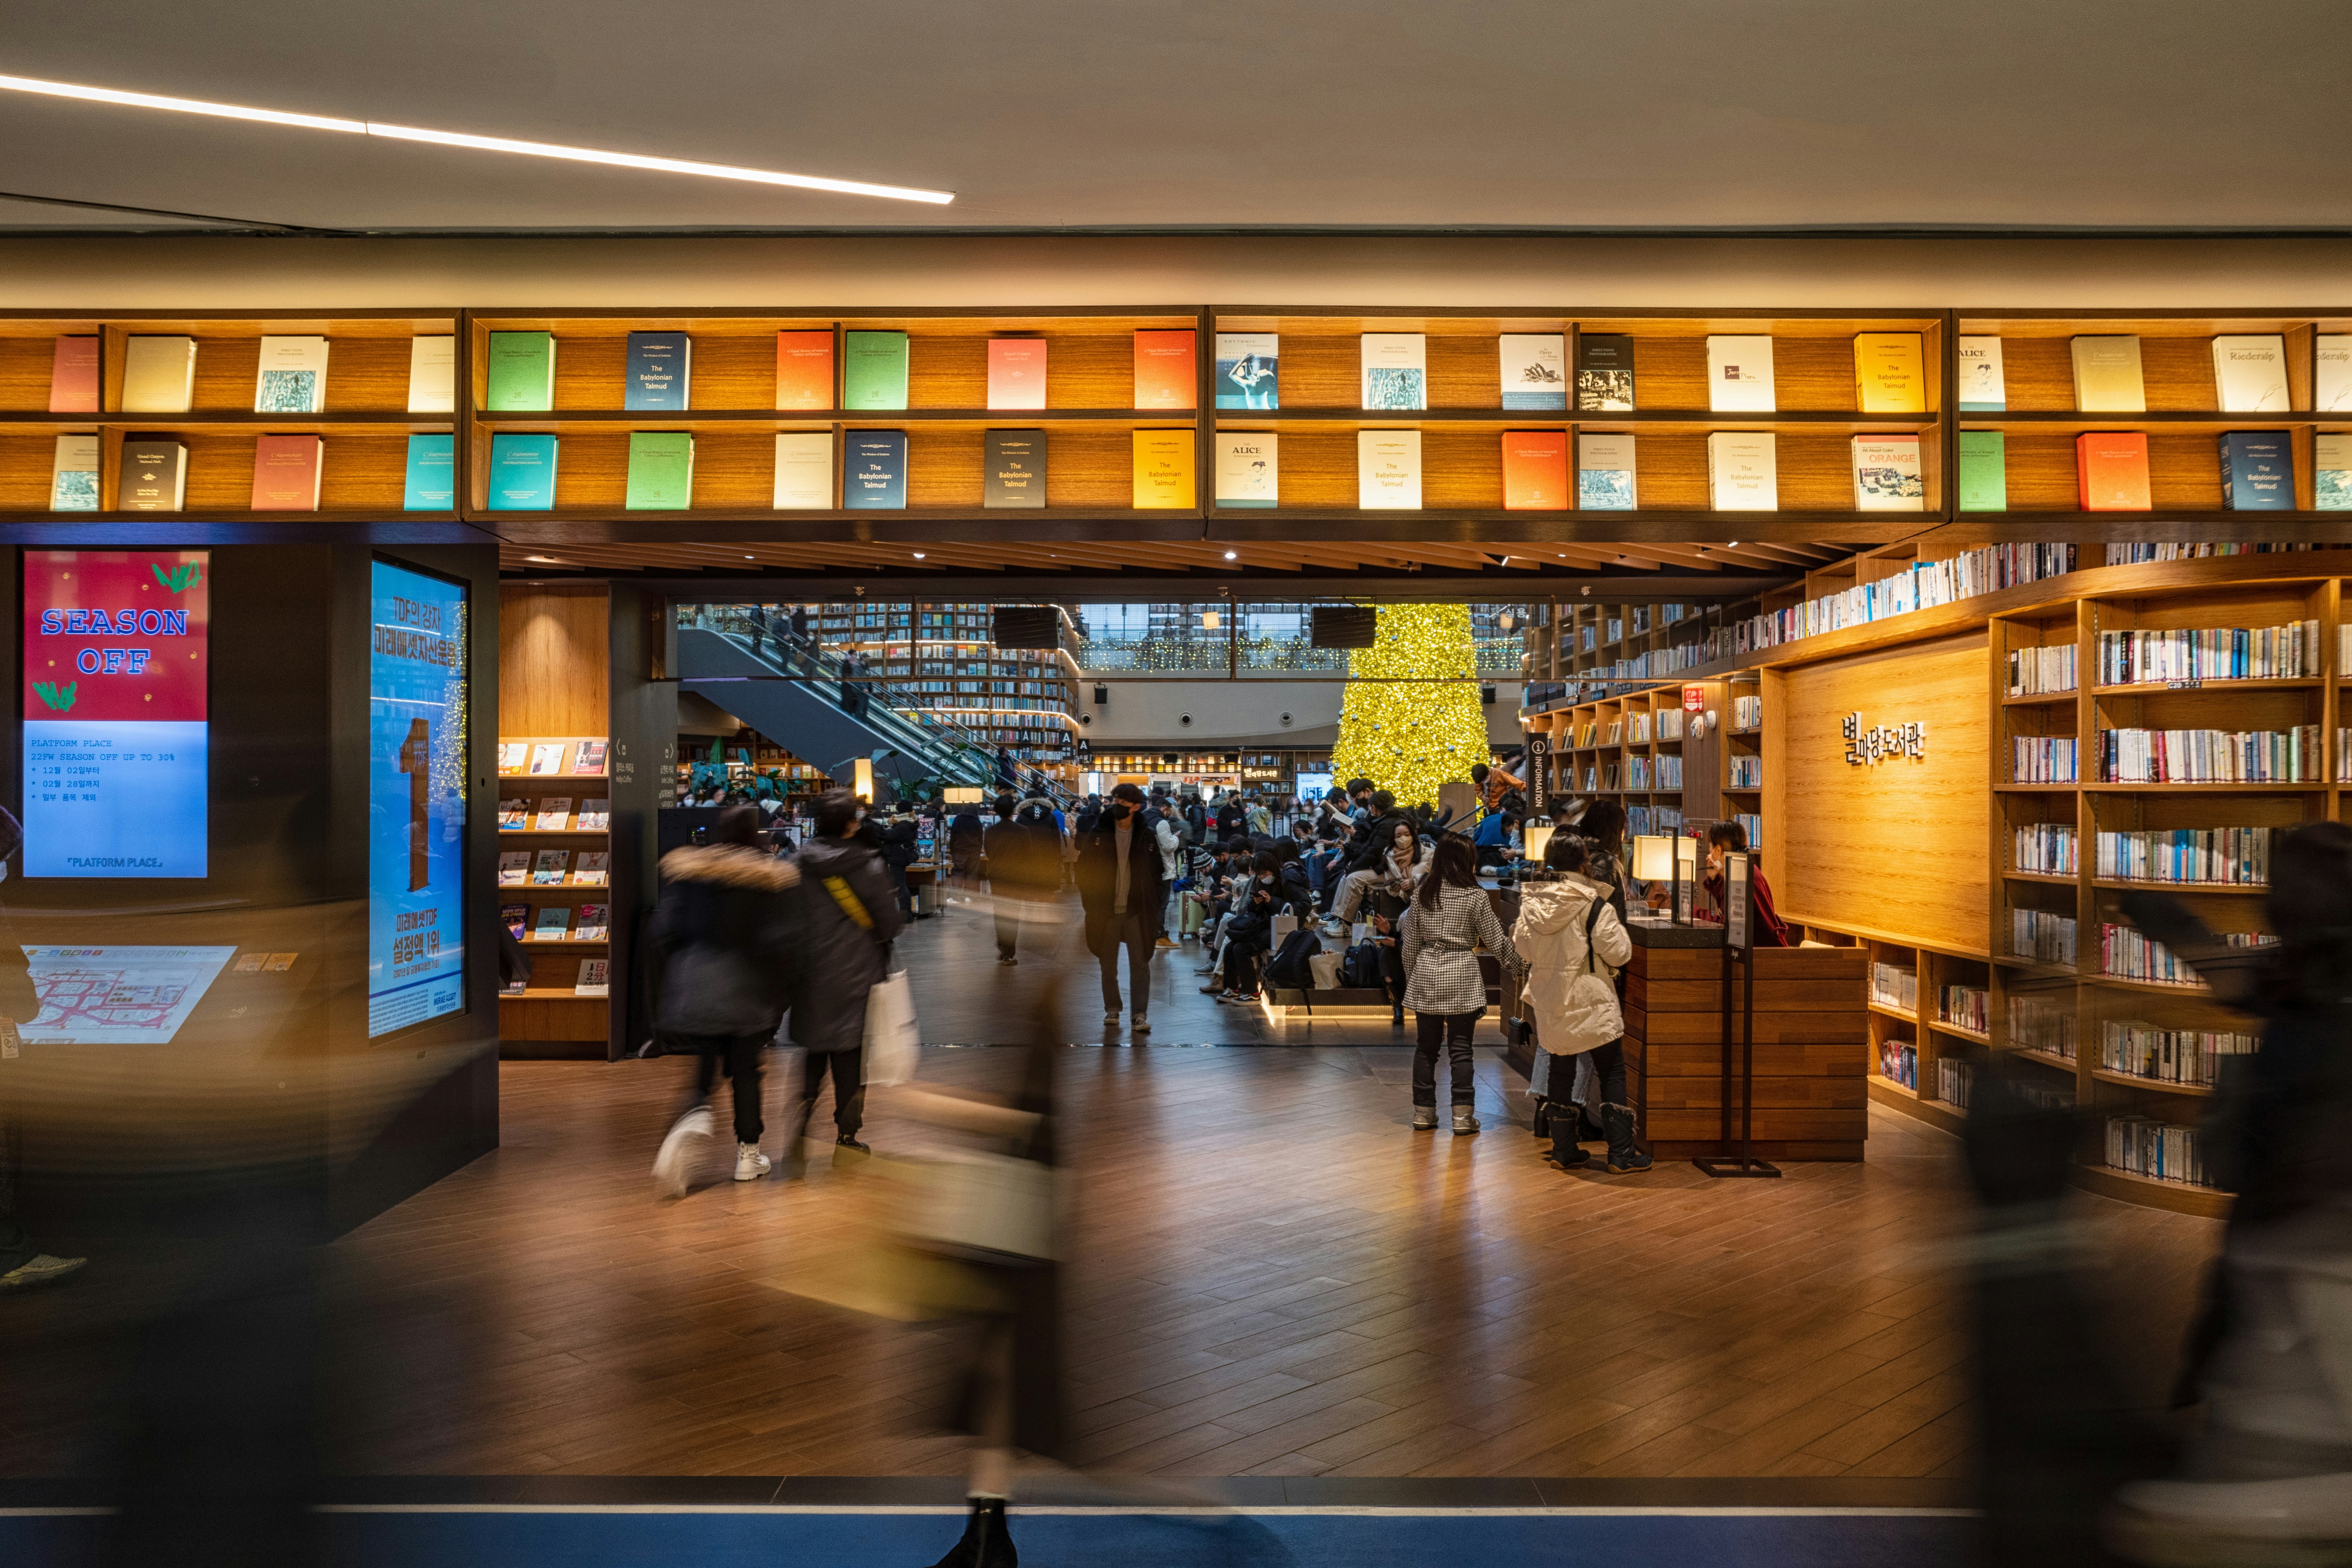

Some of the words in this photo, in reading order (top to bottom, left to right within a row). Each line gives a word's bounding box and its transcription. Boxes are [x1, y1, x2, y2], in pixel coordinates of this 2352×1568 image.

[2230, 352, 2275, 362] Riederalp
[2316, 352, 2349, 362] ederalp
[1869, 454, 1916, 463] ORANGE
[393, 595, 419, 626] TDF의
[423, 604, 441, 631] 강자
[42, 609, 189, 635] SEASON
[375, 626, 455, 668] 미래에셋자산운용
[77, 648, 151, 674] OFF
[1023, 730, 1029, 740] A
[1062, 733, 1071, 742] A
[1842, 711, 1923, 765] 별마당도서관
[1080, 740, 1087, 749] A
[414, 751, 426, 766] TDF
[1243, 767, 1278, 778] 별마당도서관
[396, 908, 437, 932] 미래에셋TDF
[393, 933, 423, 965] 설정액
[427, 929, 439, 956] 1위
[589, 962, 605, 971] 1日
[586, 972, 604, 981] 2分
[434, 996, 445, 1006] MIRAE
[445, 992, 456, 1002] ASSET
